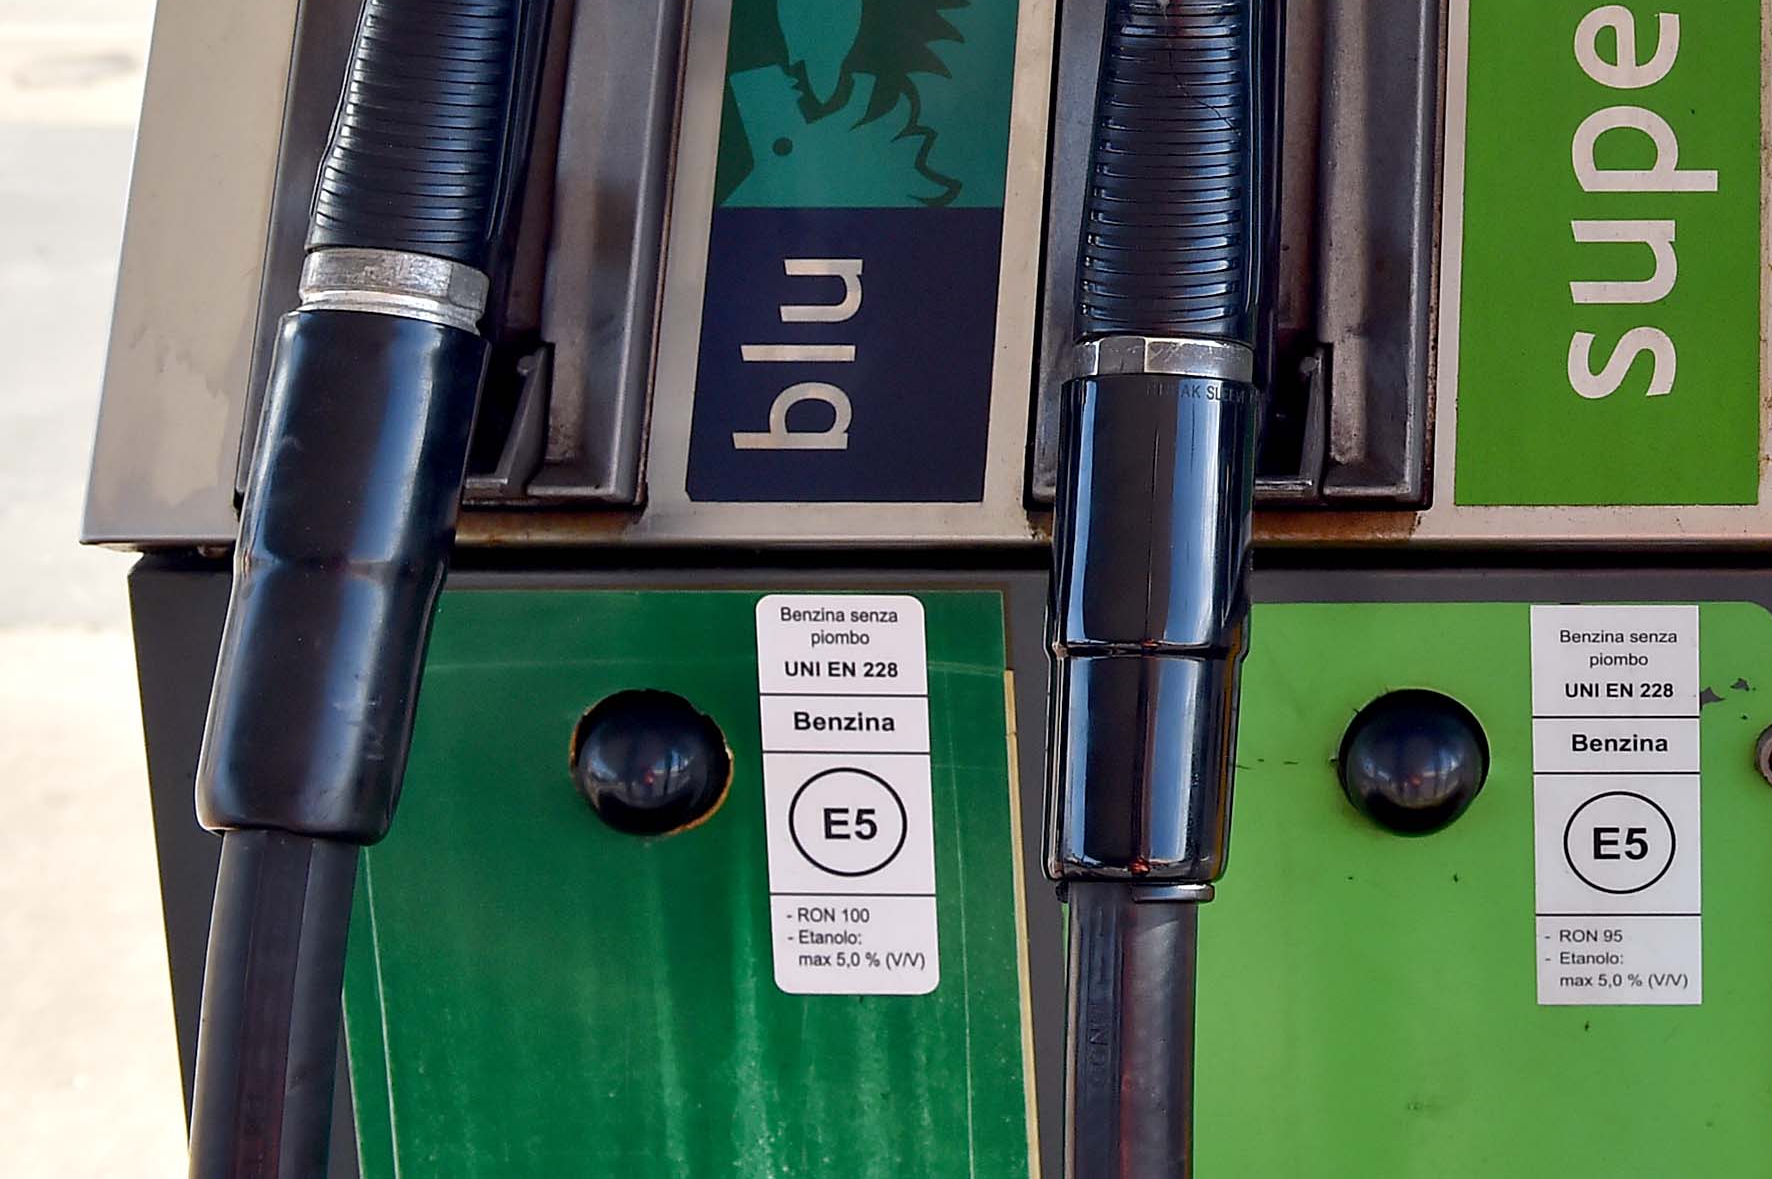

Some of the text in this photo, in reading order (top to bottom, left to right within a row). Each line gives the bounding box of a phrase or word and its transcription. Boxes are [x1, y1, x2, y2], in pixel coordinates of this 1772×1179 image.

[732, 259, 863, 449] blu
[781, 607, 897, 622] Benzina senza
[811, 630, 869, 647] piombo
[1560, 630, 1677, 643] Benzina senza
[1590, 653, 1648, 668] piombo
[785, 661, 897, 677] UNI EN 228
[1566, 683, 1673, 697] UNI EN 228
[794, 712, 894, 731] Benzina
[1572, 734, 1667, 751] Benzina
[824, 808, 877, 840] E5
[1594, 828, 1648, 860] E5
[798, 908, 835, 922] RON
[843, 908, 869, 923] 100
[799, 930, 861, 944] Etanolo:
[1560, 930, 1597, 942] RON
[1604, 930, 1622, 942] 95
[799, 952, 925, 970] max 5,0 % (V/V)
[1560, 952, 1623, 964] Etanolo:
[1560, 974, 1688, 989] max 5,0 % (V/V)
